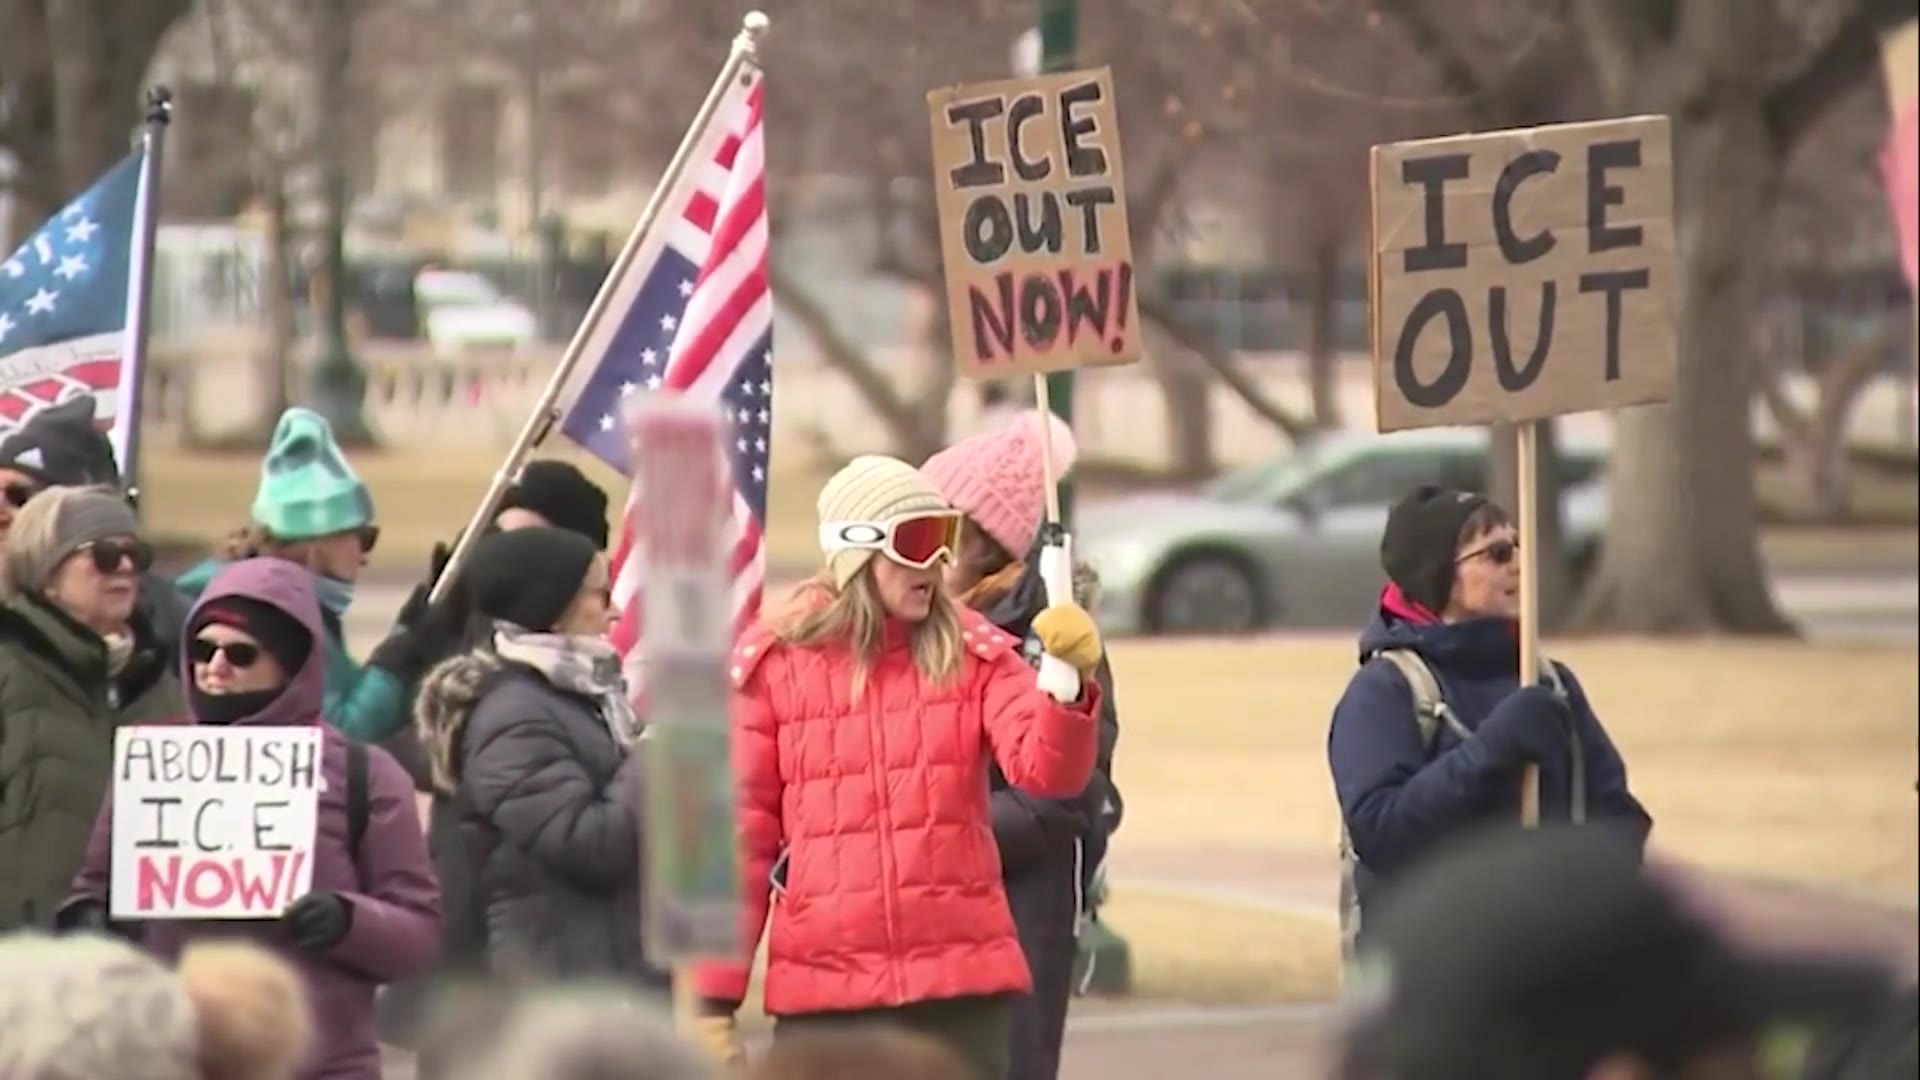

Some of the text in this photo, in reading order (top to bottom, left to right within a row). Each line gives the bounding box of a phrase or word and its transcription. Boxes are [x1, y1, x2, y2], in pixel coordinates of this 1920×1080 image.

[948, 82, 1108, 188] ICE
[963, 187, 1115, 265] OUT
[1402, 139, 1643, 272] ICE
[969, 262, 1132, 360] NOW!
[1394, 267, 1649, 408] OUT
[122, 737, 315, 788] ABOLISH
